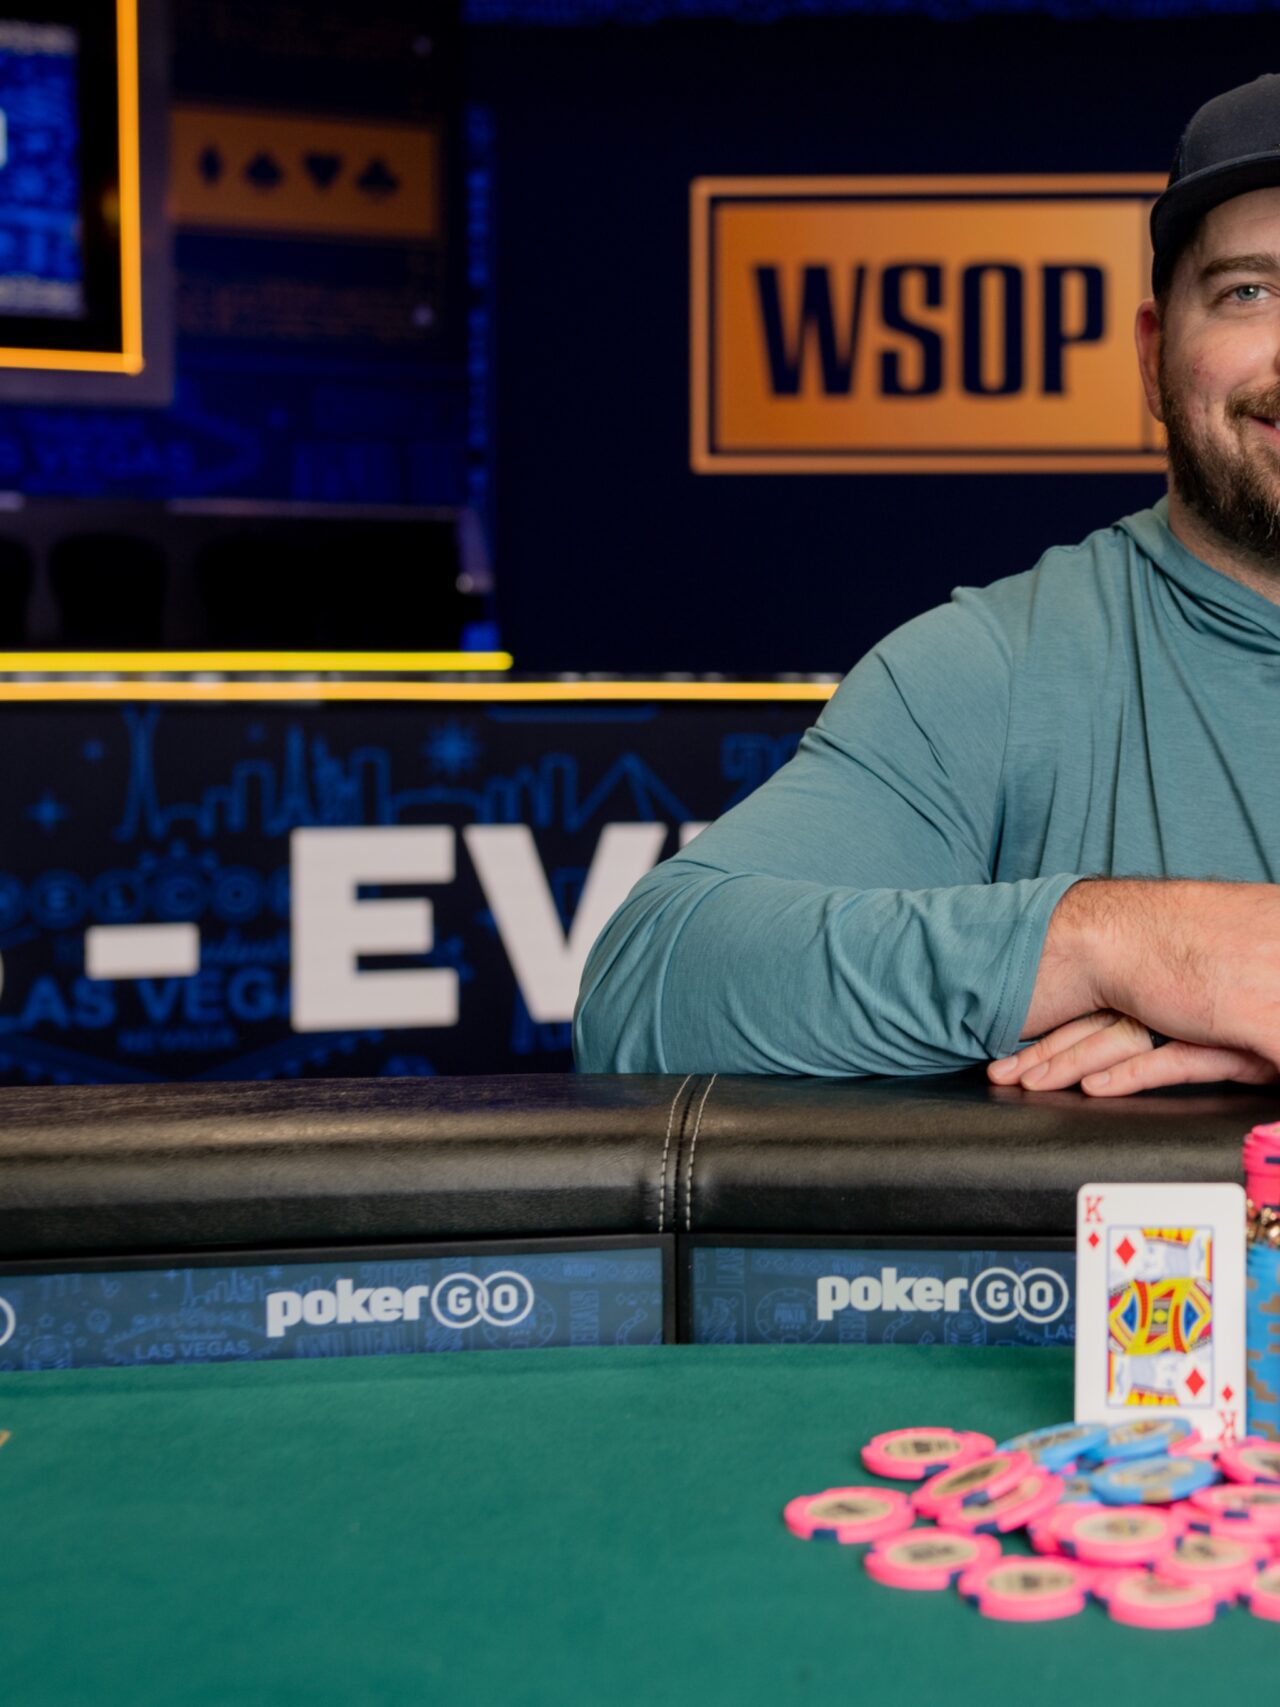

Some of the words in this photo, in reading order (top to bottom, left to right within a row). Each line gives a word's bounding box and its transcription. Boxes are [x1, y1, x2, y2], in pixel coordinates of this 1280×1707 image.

[754, 262, 1107, 396] WSOP
[291, 822, 712, 1032] EV
[135, 966, 291, 1024] VEG
[1084, 1196, 1103, 1223] K
[267, 1270, 534, 1338] pokerGO
[817, 1267, 1068, 1323] pokerGO
[134, 1342, 175, 1360] LAS
[177, 1339, 251, 1357] VEGAS
[1218, 1411, 1237, 1440] K
